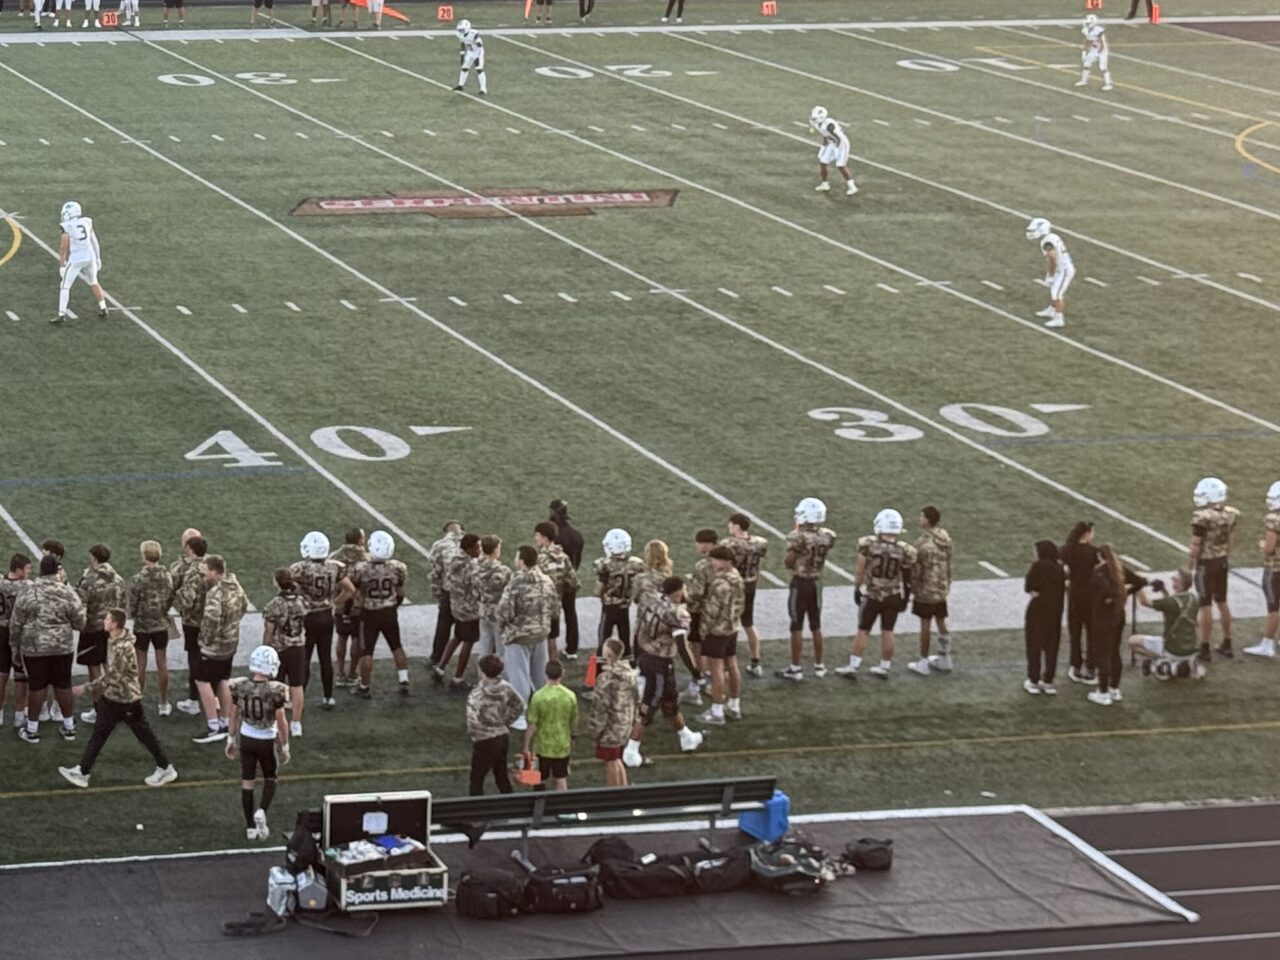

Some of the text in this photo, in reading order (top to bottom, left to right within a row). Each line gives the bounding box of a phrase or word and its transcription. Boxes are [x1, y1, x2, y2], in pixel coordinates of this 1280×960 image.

[77, 225, 87, 241] 3
[368, 578, 392, 599] 29
[244, 694, 263, 721] 10
[346, 889, 389, 905] Sports
